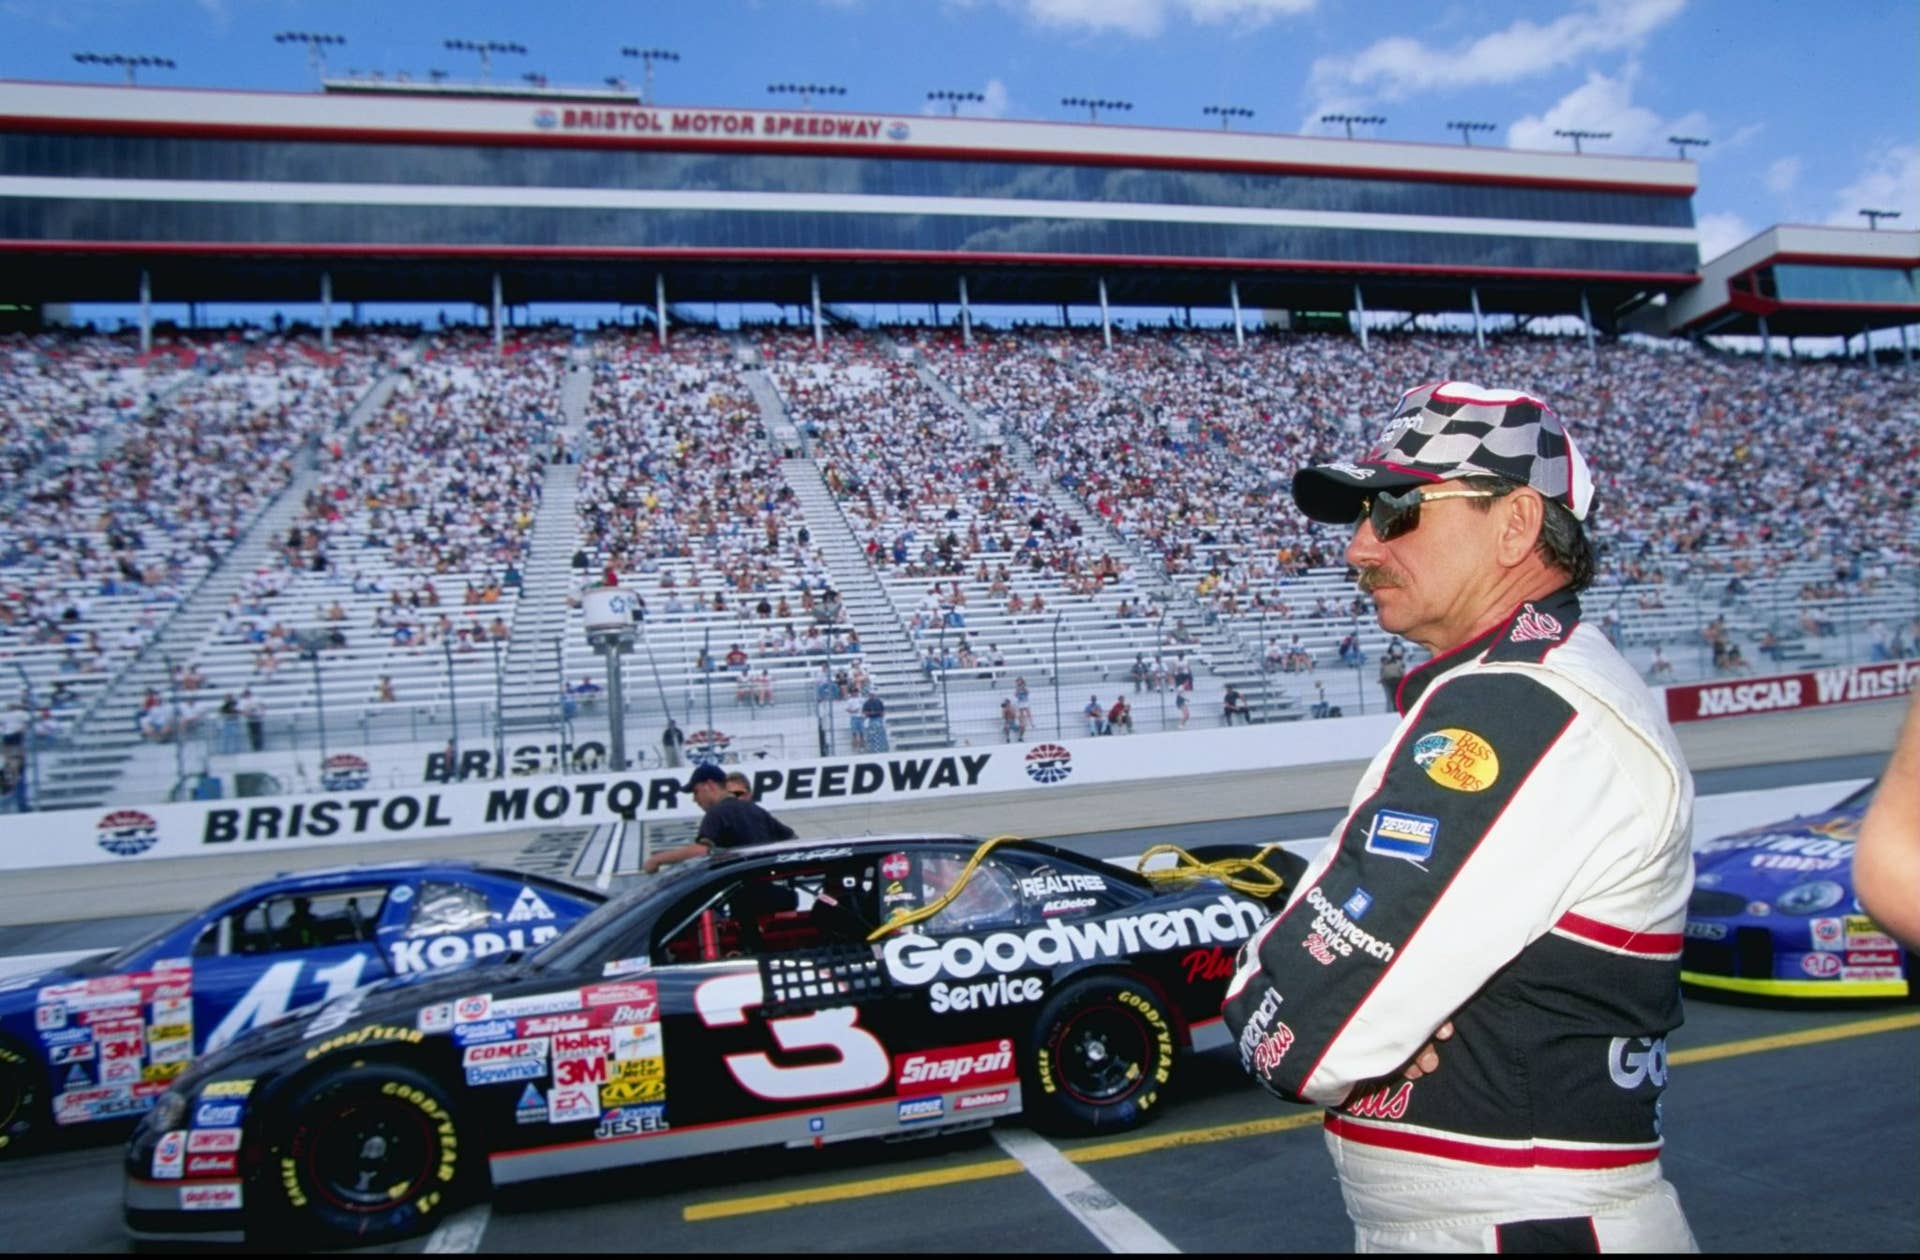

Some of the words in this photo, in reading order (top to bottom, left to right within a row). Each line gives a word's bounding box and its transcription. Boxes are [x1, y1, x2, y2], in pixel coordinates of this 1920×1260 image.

[562, 109, 663, 132] BRISTOL
[671, 113, 755, 135] MOTOR
[763, 116, 882, 138] SPEEDWAY
[1697, 679, 1802, 716] NASCAR
[1449, 744, 1476, 769] Pro
[1457, 733, 1492, 761] Bass
[1441, 761, 1484, 790] Shops
[204, 795, 452, 845] BRISTOL
[485, 777, 684, 823] MOTOR
[750, 753, 992, 801] PEEDWAY
[1021, 874, 1107, 898] REALTREE
[883, 896, 1266, 986] Goodwrench
[1306, 886, 1395, 962] Goodwrench
[1311, 915, 1353, 956] Service
[1182, 944, 1234, 984] Plu
[930, 973, 1045, 1013] Service
[611, 1001, 657, 1022] Bud
[305, 1024, 424, 1060] GOODYEAR
[469, 1043, 529, 1062] COMP
[555, 1032, 611, 1053] Holley
[692, 970, 892, 1101] 3
[1118, 990, 1173, 1084] GOODYEAR
[1254, 1021, 1295, 1080] Plus
[468, 1063, 545, 1085] Bowman
[557, 1056, 606, 1086] 3M
[899, 1051, 1013, 1084] Snap-on
[1038, 1048, 1057, 1094] EAGLE
[382, 1081, 458, 1183] GOODYEAR
[596, 1114, 669, 1138] JESEL
